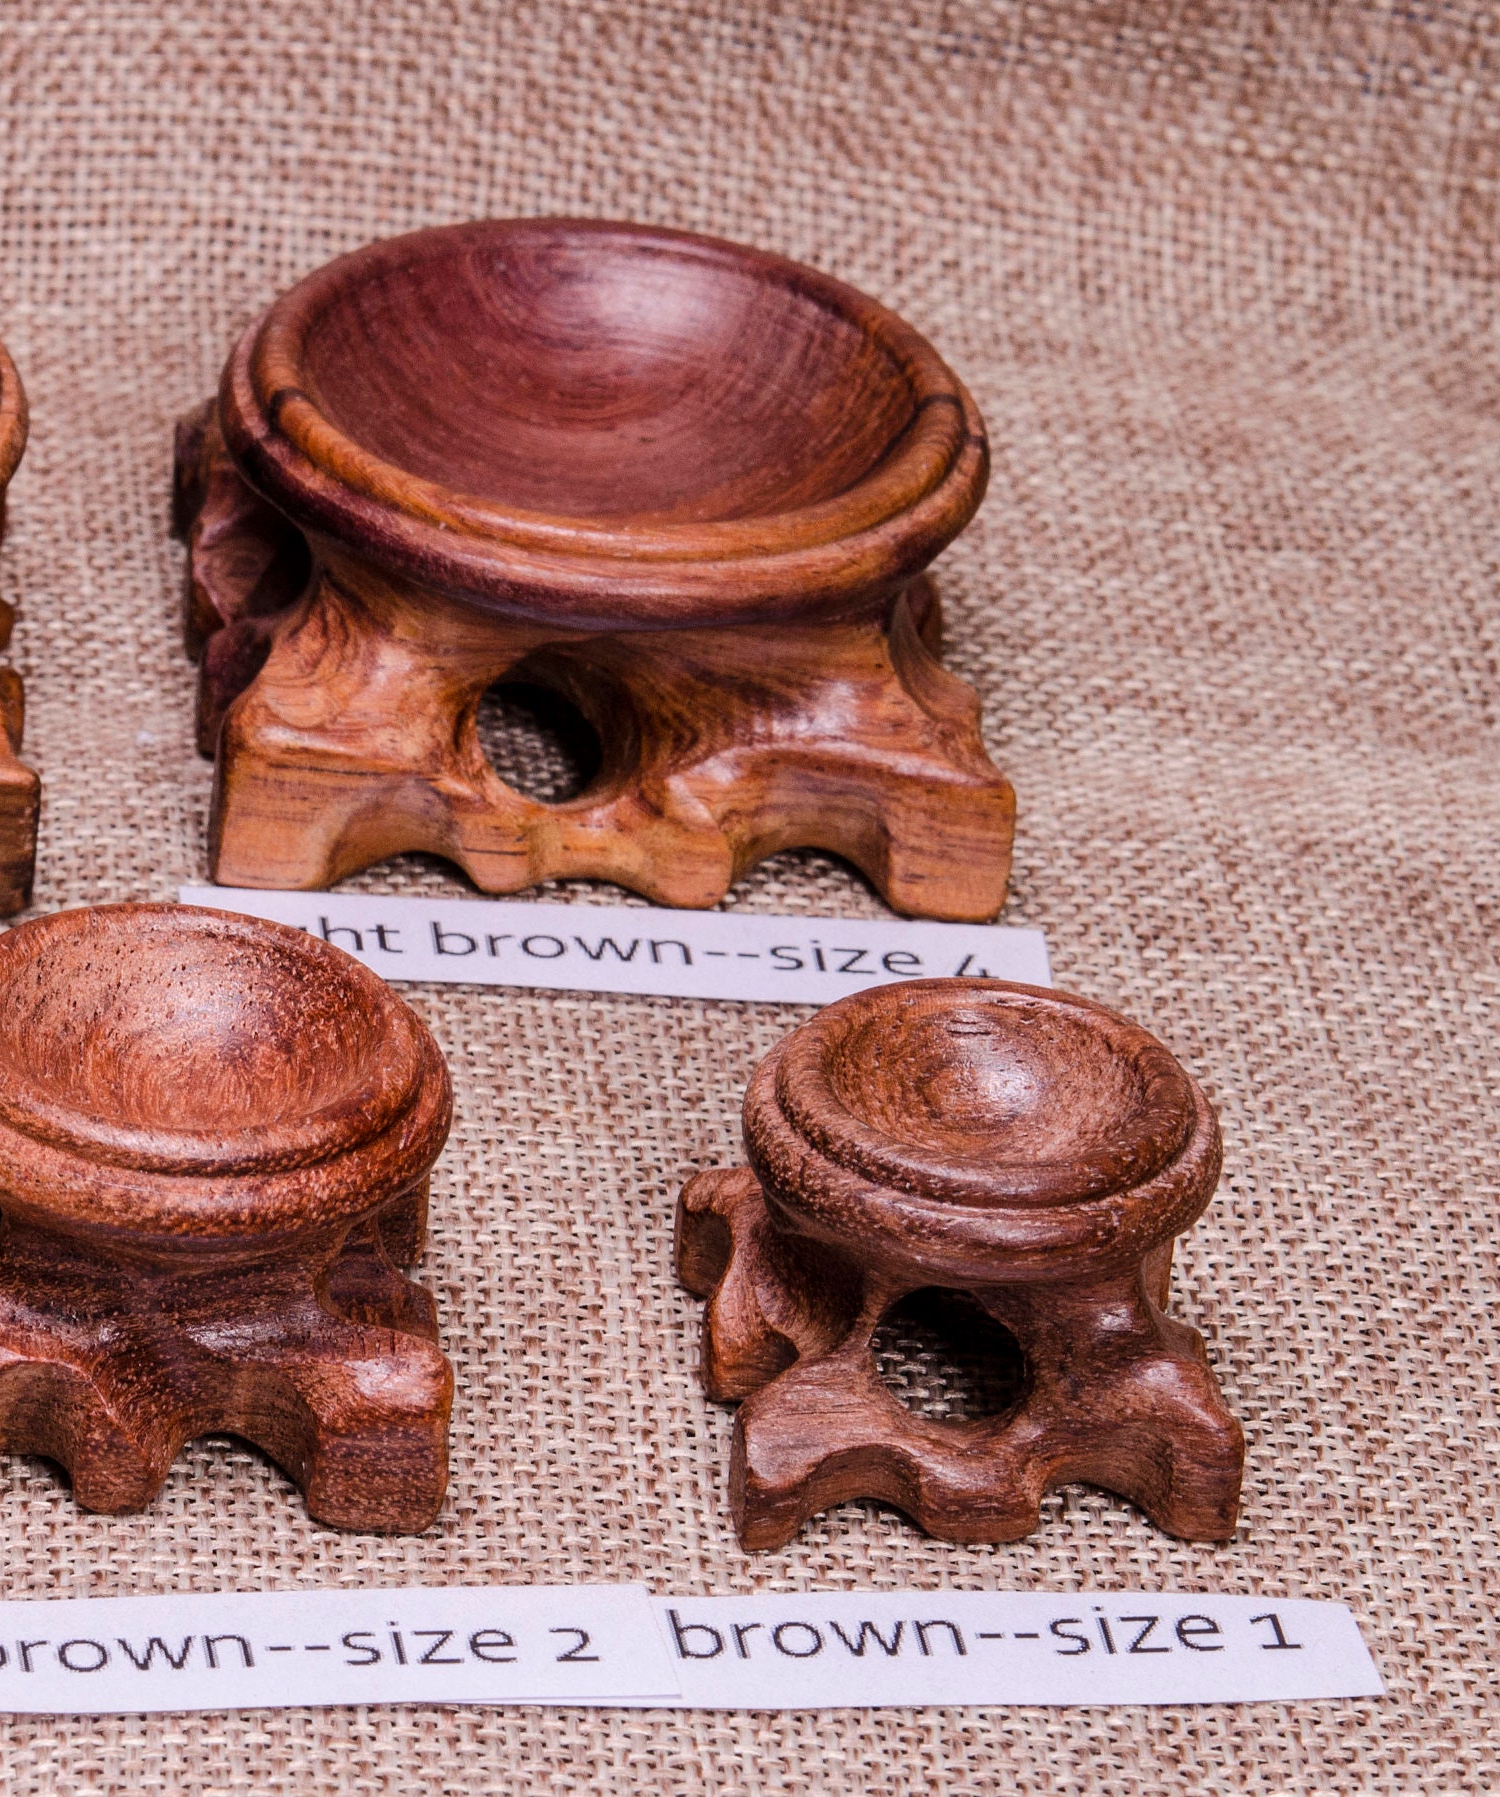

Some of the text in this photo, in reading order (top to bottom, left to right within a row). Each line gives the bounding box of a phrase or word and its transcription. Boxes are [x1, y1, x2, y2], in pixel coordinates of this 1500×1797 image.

[295, 916, 999, 979] ht brown--size 4
[548, 1626, 600, 1663] 2
[666, 1605, 1303, 1660] brown--size 1
